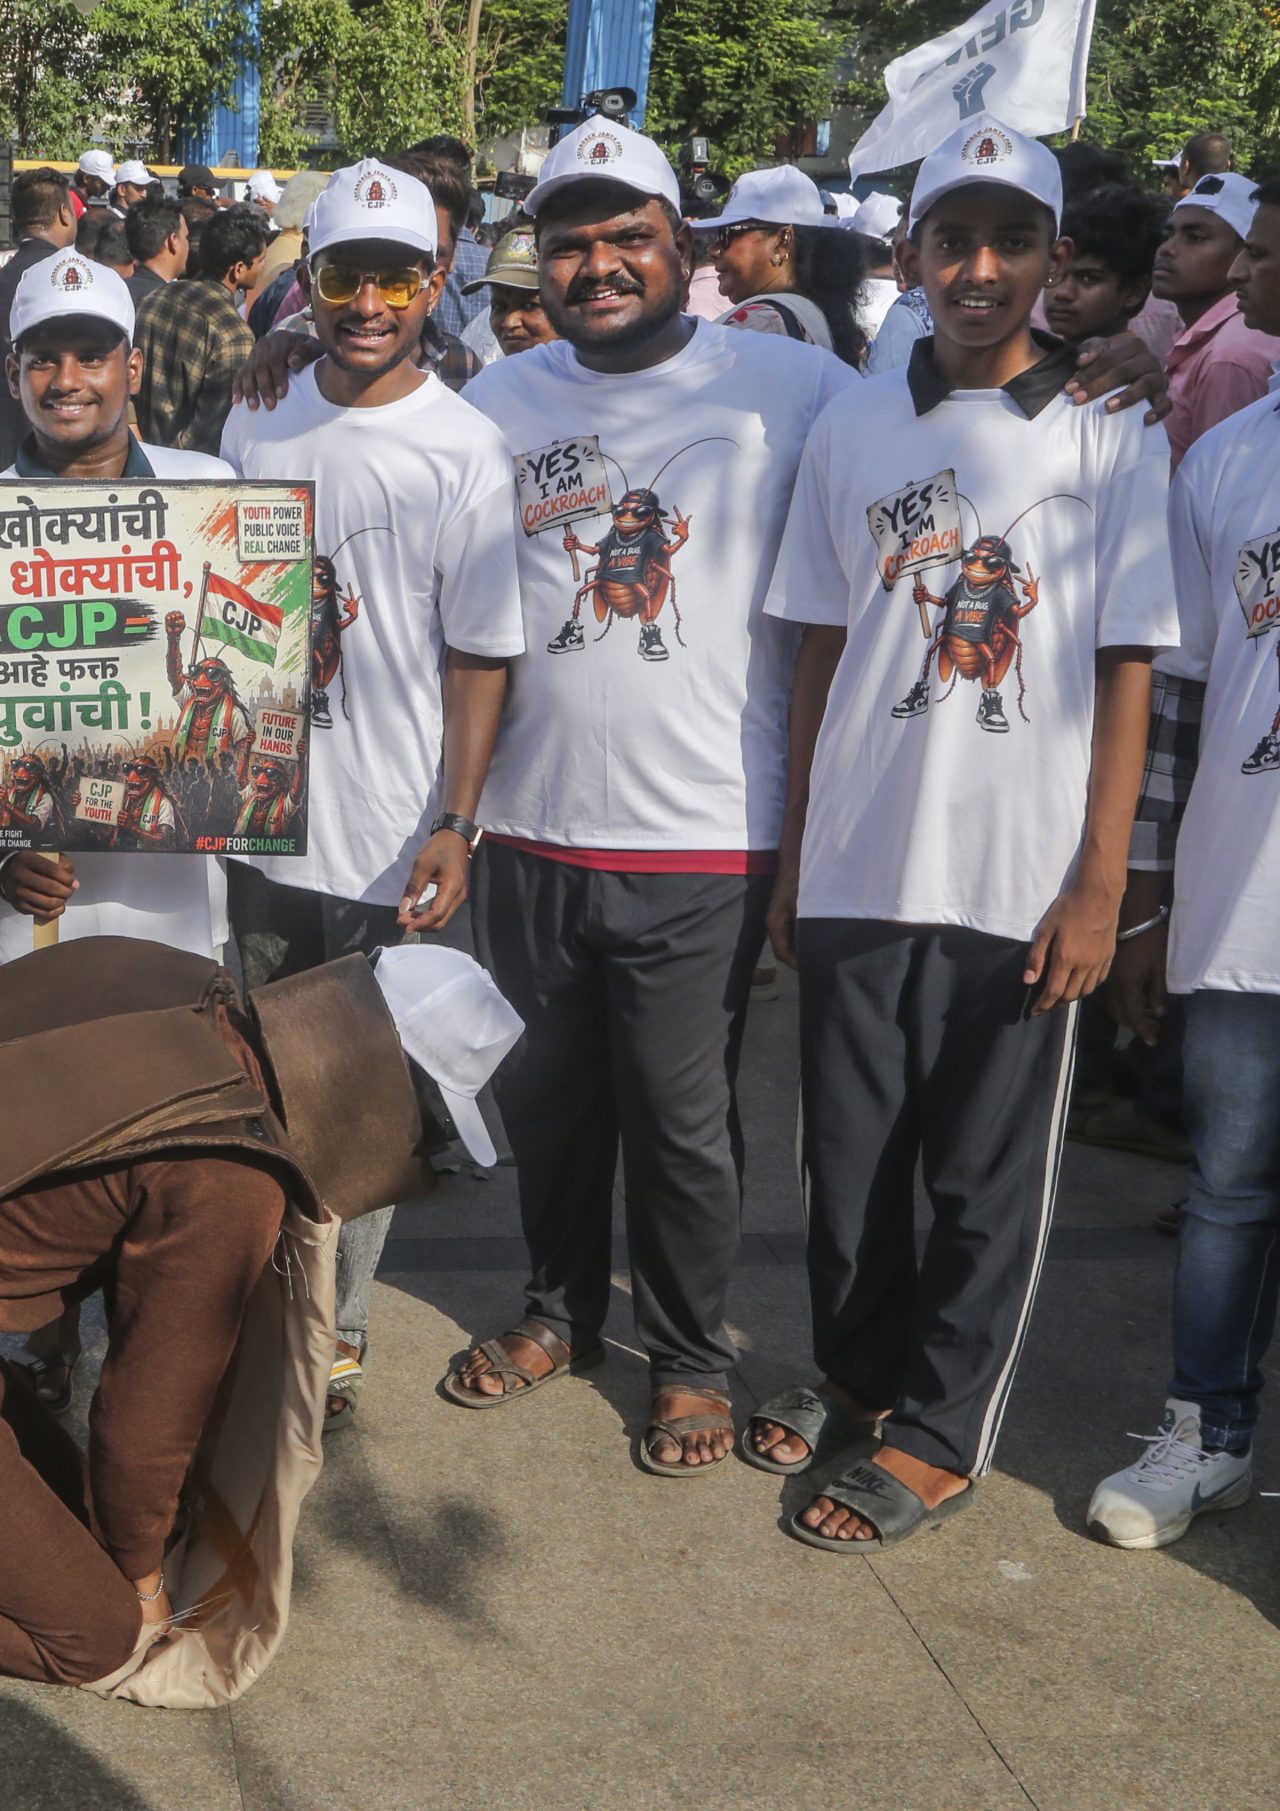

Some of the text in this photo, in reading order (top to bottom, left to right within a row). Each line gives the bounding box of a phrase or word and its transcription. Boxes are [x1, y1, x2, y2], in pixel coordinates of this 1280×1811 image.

[976, 157, 997, 166] CJP
[367, 201, 385, 209] CJP
[64, 284, 82, 292] CJP
[526, 443, 580, 484] YES
[539, 472, 583, 500] I AM
[242, 506, 302, 520] YOUTH POWER
[524, 483, 607, 527] COCKROACH
[880, 483, 934, 533] YES
[244, 522, 300, 537] PUBLIC VOICE
[244, 540, 301, 554] REAL CHANGE
[898, 531, 912, 550] I
[10, 540, 193, 599] धोक्यांची,
[956, 600, 969, 610] NOT
[222, 600, 262, 637] CJP
[954, 610, 986, 622] A VIBE
[7, 601, 117, 650] CJP
[56, 656, 120, 681] फक्त
[261, 711, 298, 729] FUTURE
[262, 725, 294, 742] IN OUR
[259, 738, 293, 756] HANDS
[89, 782, 113, 798] CJP
[85, 797, 114, 809] FOR THE
[83, 807, 112, 821] YOUTH
[4, 829, 23, 839] FIGHT
[7, 838, 32, 849] CHANGE
[195, 836, 296, 852] #CJPFORCHANGE
[846, 1466, 890, 1491] NIKE
